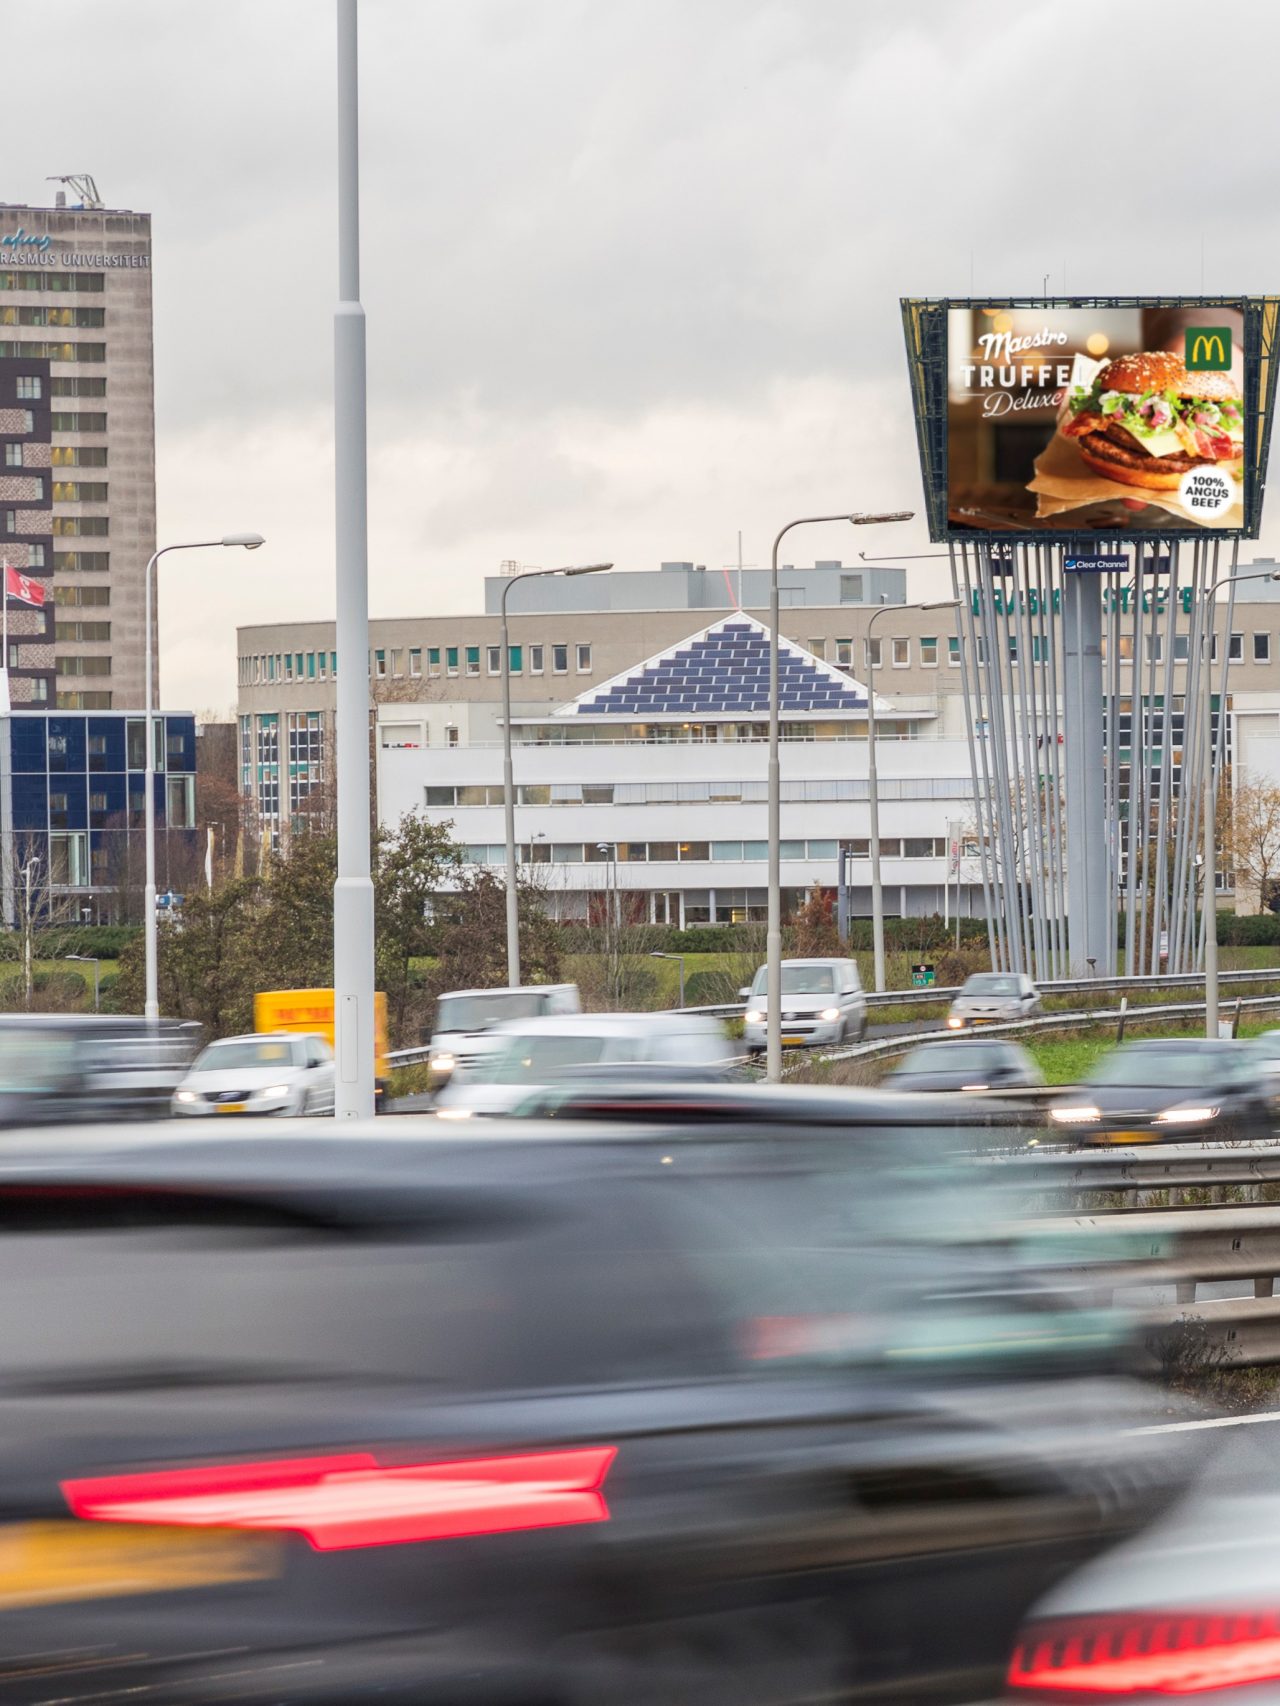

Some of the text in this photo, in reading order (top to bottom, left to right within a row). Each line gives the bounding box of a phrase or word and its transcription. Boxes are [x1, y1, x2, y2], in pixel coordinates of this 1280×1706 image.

[61, 254, 150, 268] UNIVERSITEIT
[978, 327, 1068, 365] Maestro
[982, 388, 1063, 418] Deluxe
[1192, 475, 1225, 488] 100%
[1185, 485, 1229, 499] ANGUS
[1191, 496, 1222, 509] BEEF
[1076, 560, 1128, 569] Clear Channel
